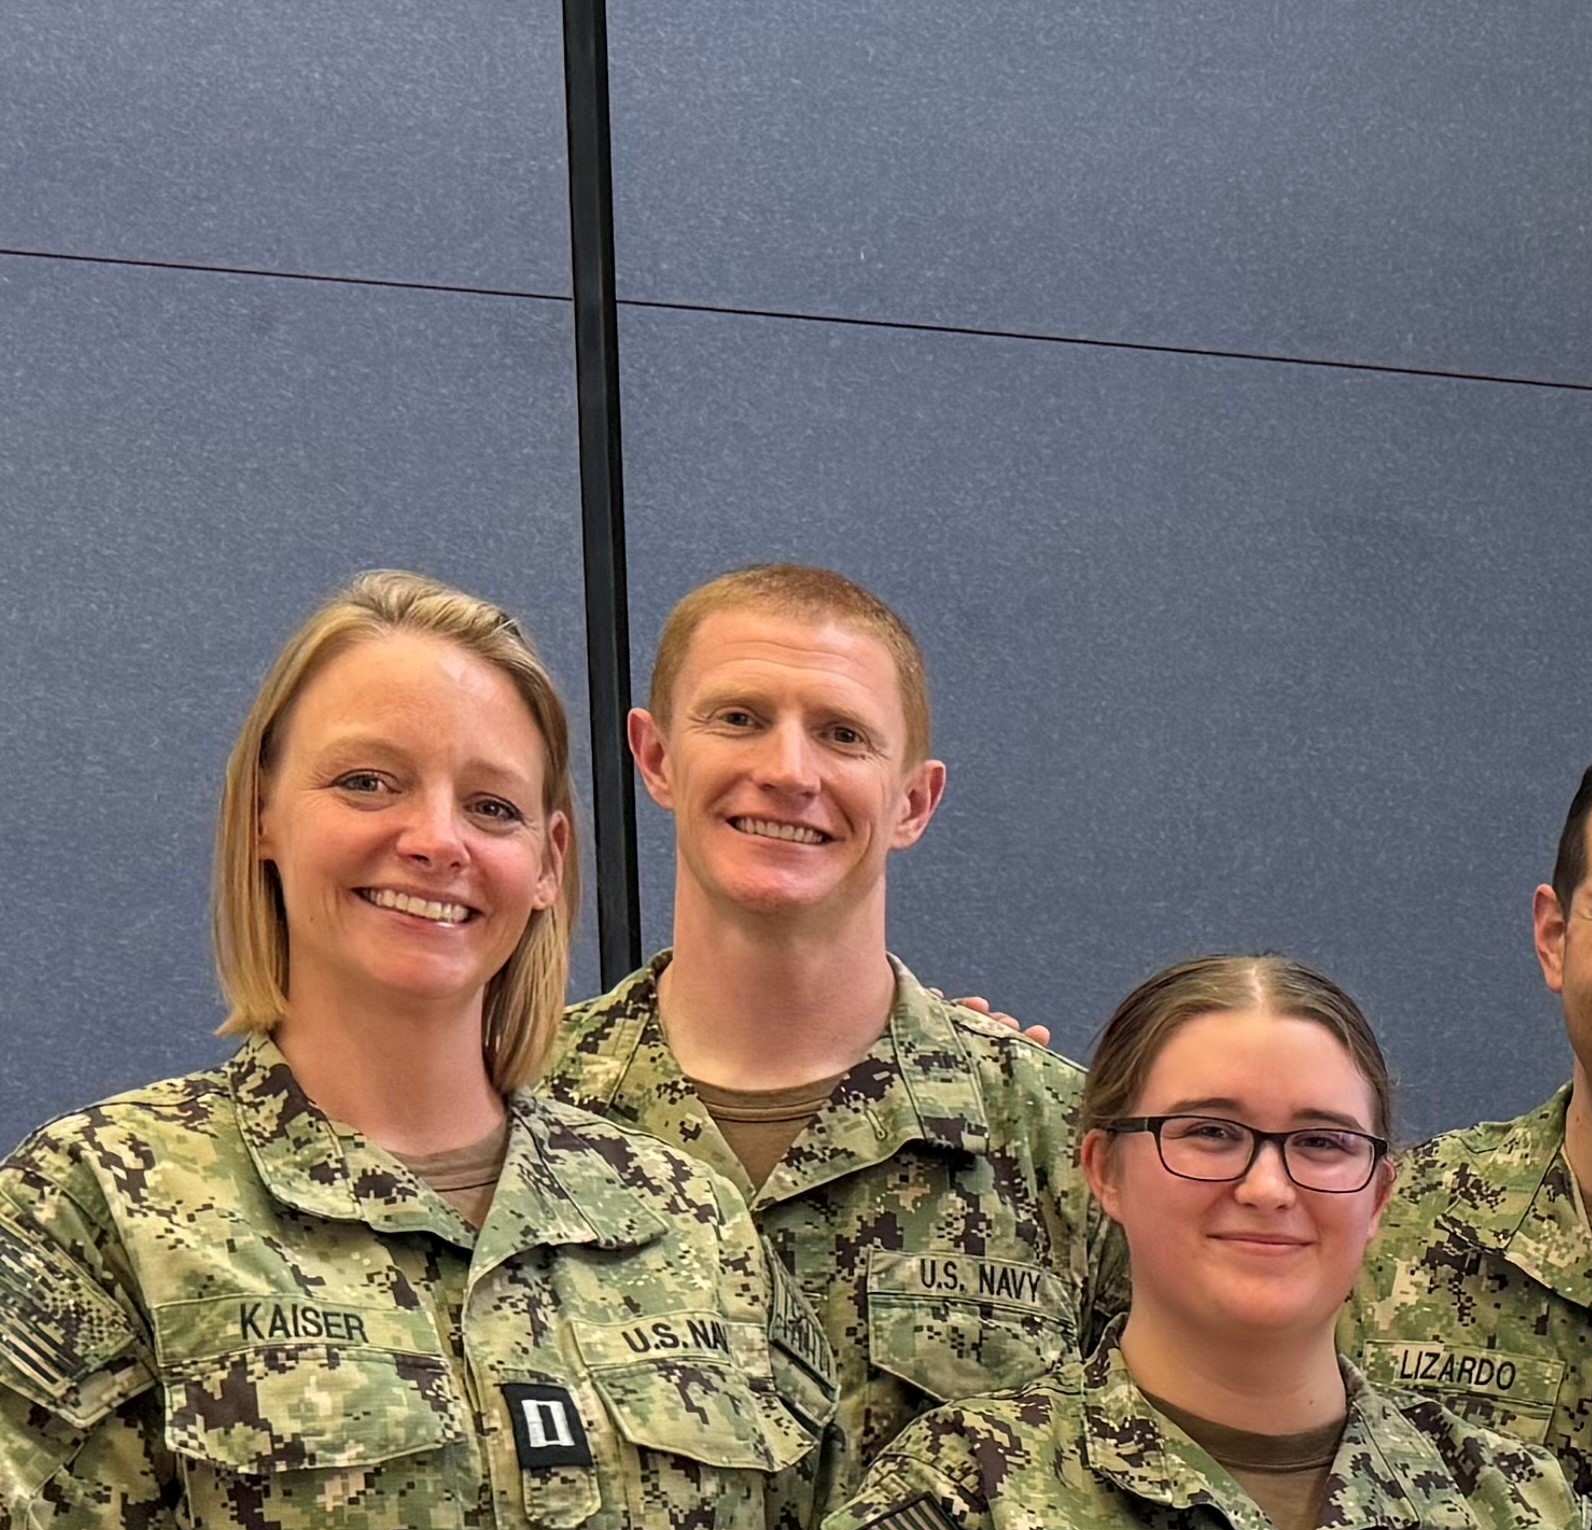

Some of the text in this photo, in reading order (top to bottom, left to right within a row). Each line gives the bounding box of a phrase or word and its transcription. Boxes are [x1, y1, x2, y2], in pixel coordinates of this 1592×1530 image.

[920, 1258, 1040, 1303] U.S. NAVY
[240, 1302, 369, 1343] KAISER
[621, 1322, 689, 1354] U.S.
[1399, 1349, 1516, 1391] LIZARDO
